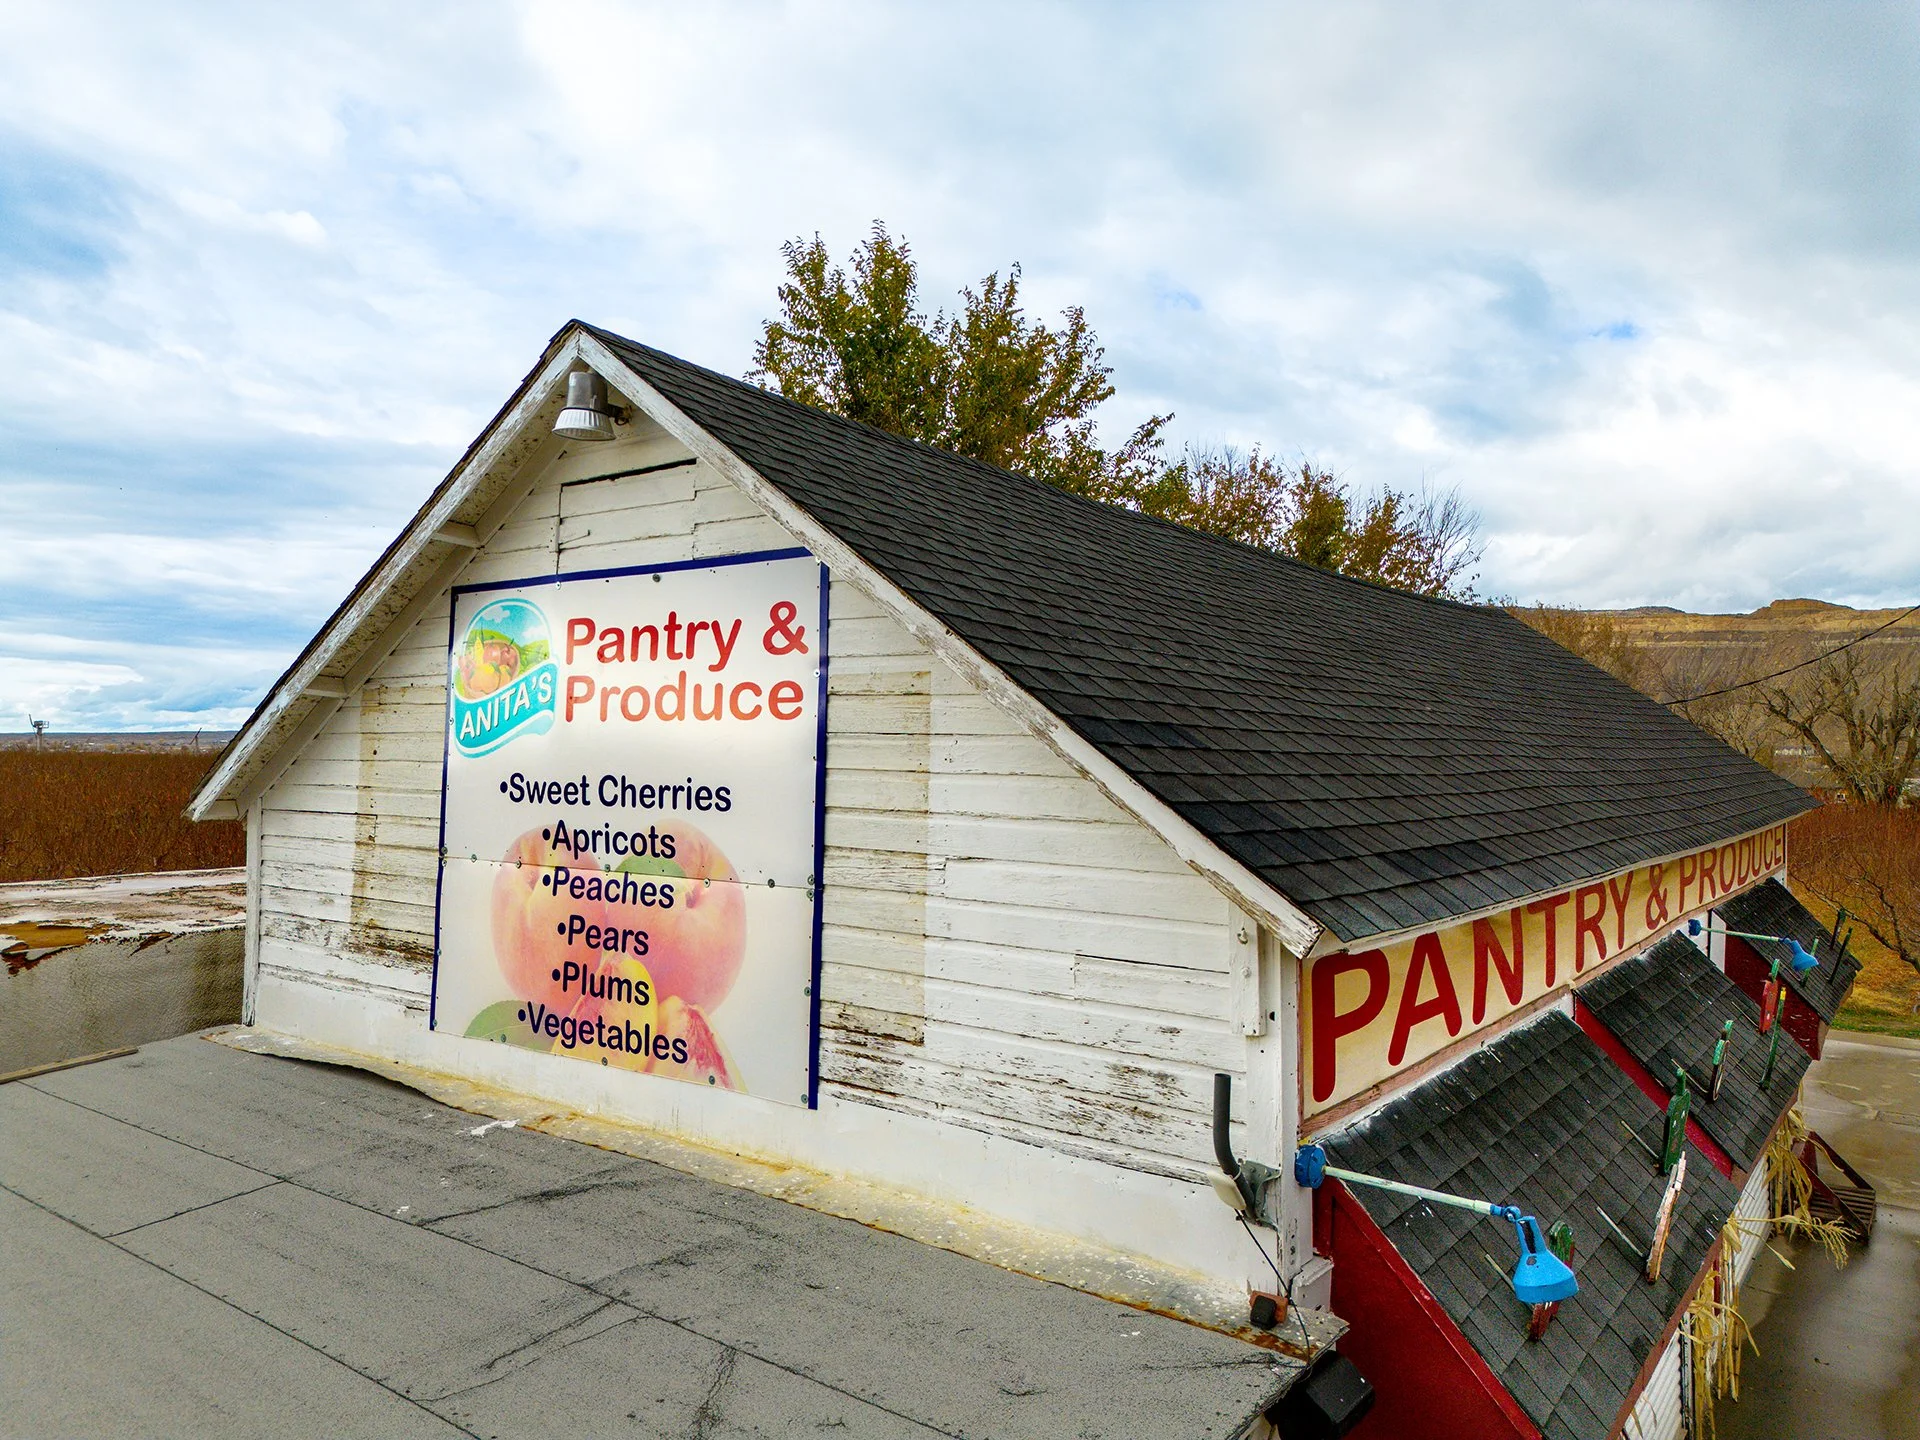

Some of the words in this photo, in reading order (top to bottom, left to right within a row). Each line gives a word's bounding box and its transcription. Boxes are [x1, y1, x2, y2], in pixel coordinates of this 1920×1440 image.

[565, 611, 742, 672] Pantry
[762, 600, 809, 656] &
[459, 671, 553, 741] ANITA'S
[565, 670, 804, 723] Produce
[598, 775, 732, 813] Cherries
[1311, 869, 1634, 1103] PANTRY
[1645, 863, 1669, 931] &
[1679, 824, 1783, 914] PRODUCE
